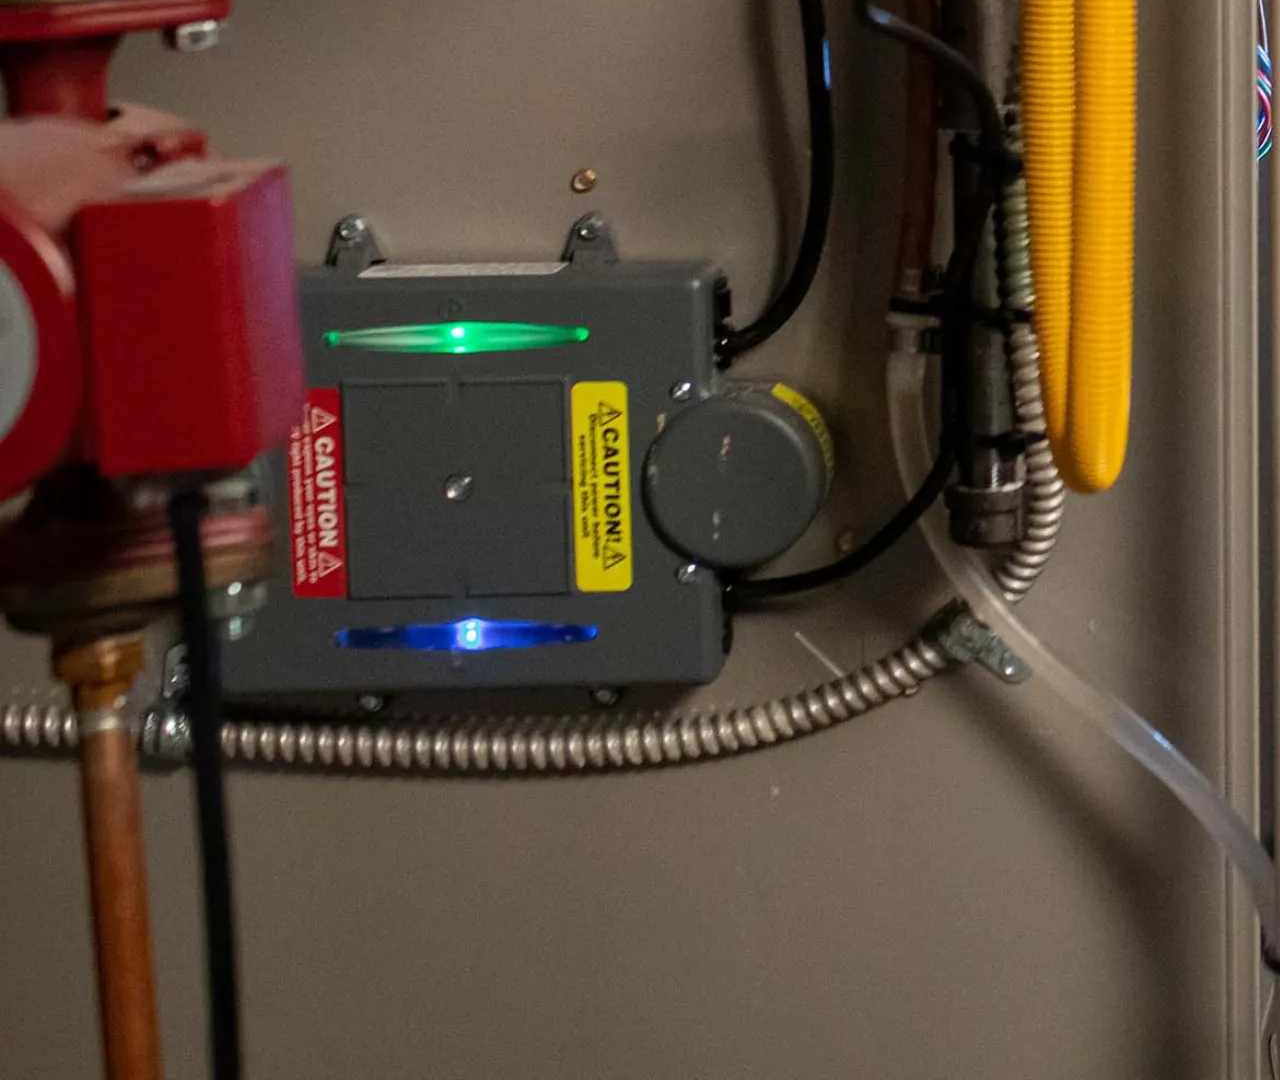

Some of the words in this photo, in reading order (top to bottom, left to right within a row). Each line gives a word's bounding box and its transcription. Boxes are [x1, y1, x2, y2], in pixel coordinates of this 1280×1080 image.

[578, 435, 588, 487] servicing
[589, 415, 599, 478] Disconnect
[291, 468, 304, 520] produced
[305, 478, 314, 502] your
[314, 436, 339, 547] CAUTION
[581, 491, 589, 512] this
[589, 483, 598, 518] power
[602, 428, 621, 543] CAUTION!
[294, 522, 305, 535] by
[582, 515, 591, 538] unit
[592, 522, 601, 559] before
